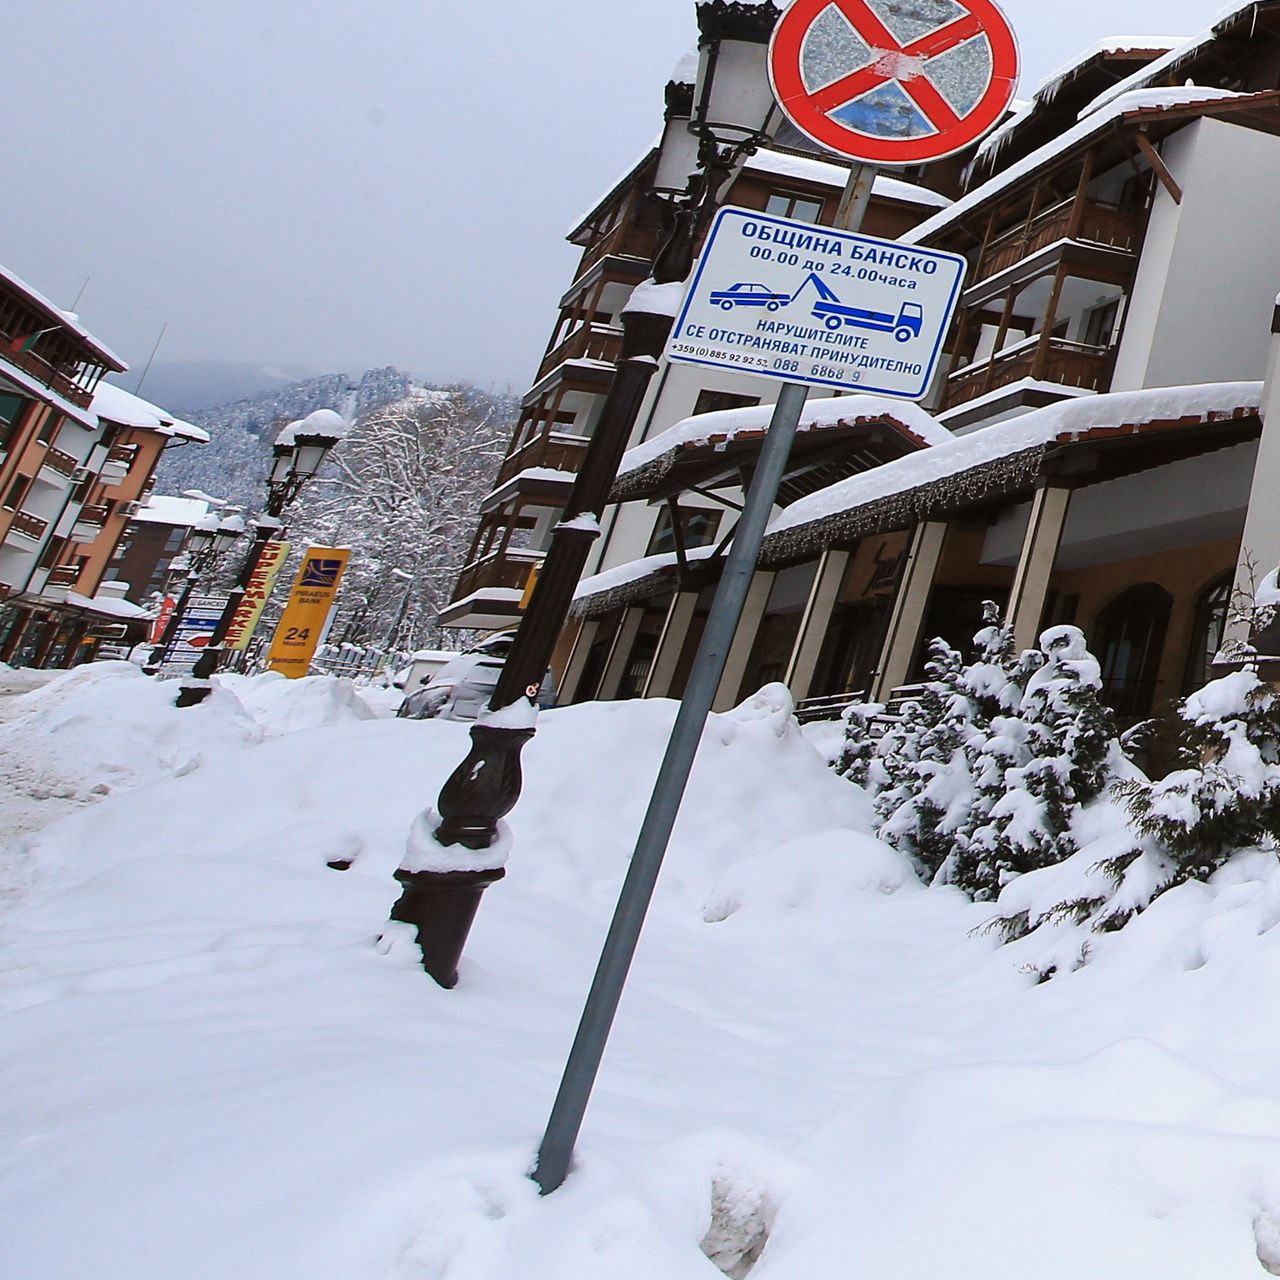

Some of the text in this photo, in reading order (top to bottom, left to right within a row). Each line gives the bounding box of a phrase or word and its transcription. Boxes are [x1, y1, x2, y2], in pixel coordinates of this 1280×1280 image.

[741, 221, 938, 275] ОБЩИНА БАНСКО
[749, 245, 918, 290] 00.00 до 24.00часа
[686, 324, 922, 376] СЕ ОТСТРАНЯВАТ ПРИНУДИТЕЛНО
[756, 319, 869, 349] НАРУШИТЕЛИТЕ
[224, 541, 282, 648] SUPERMARKET
[284, 627, 310, 640] 24
